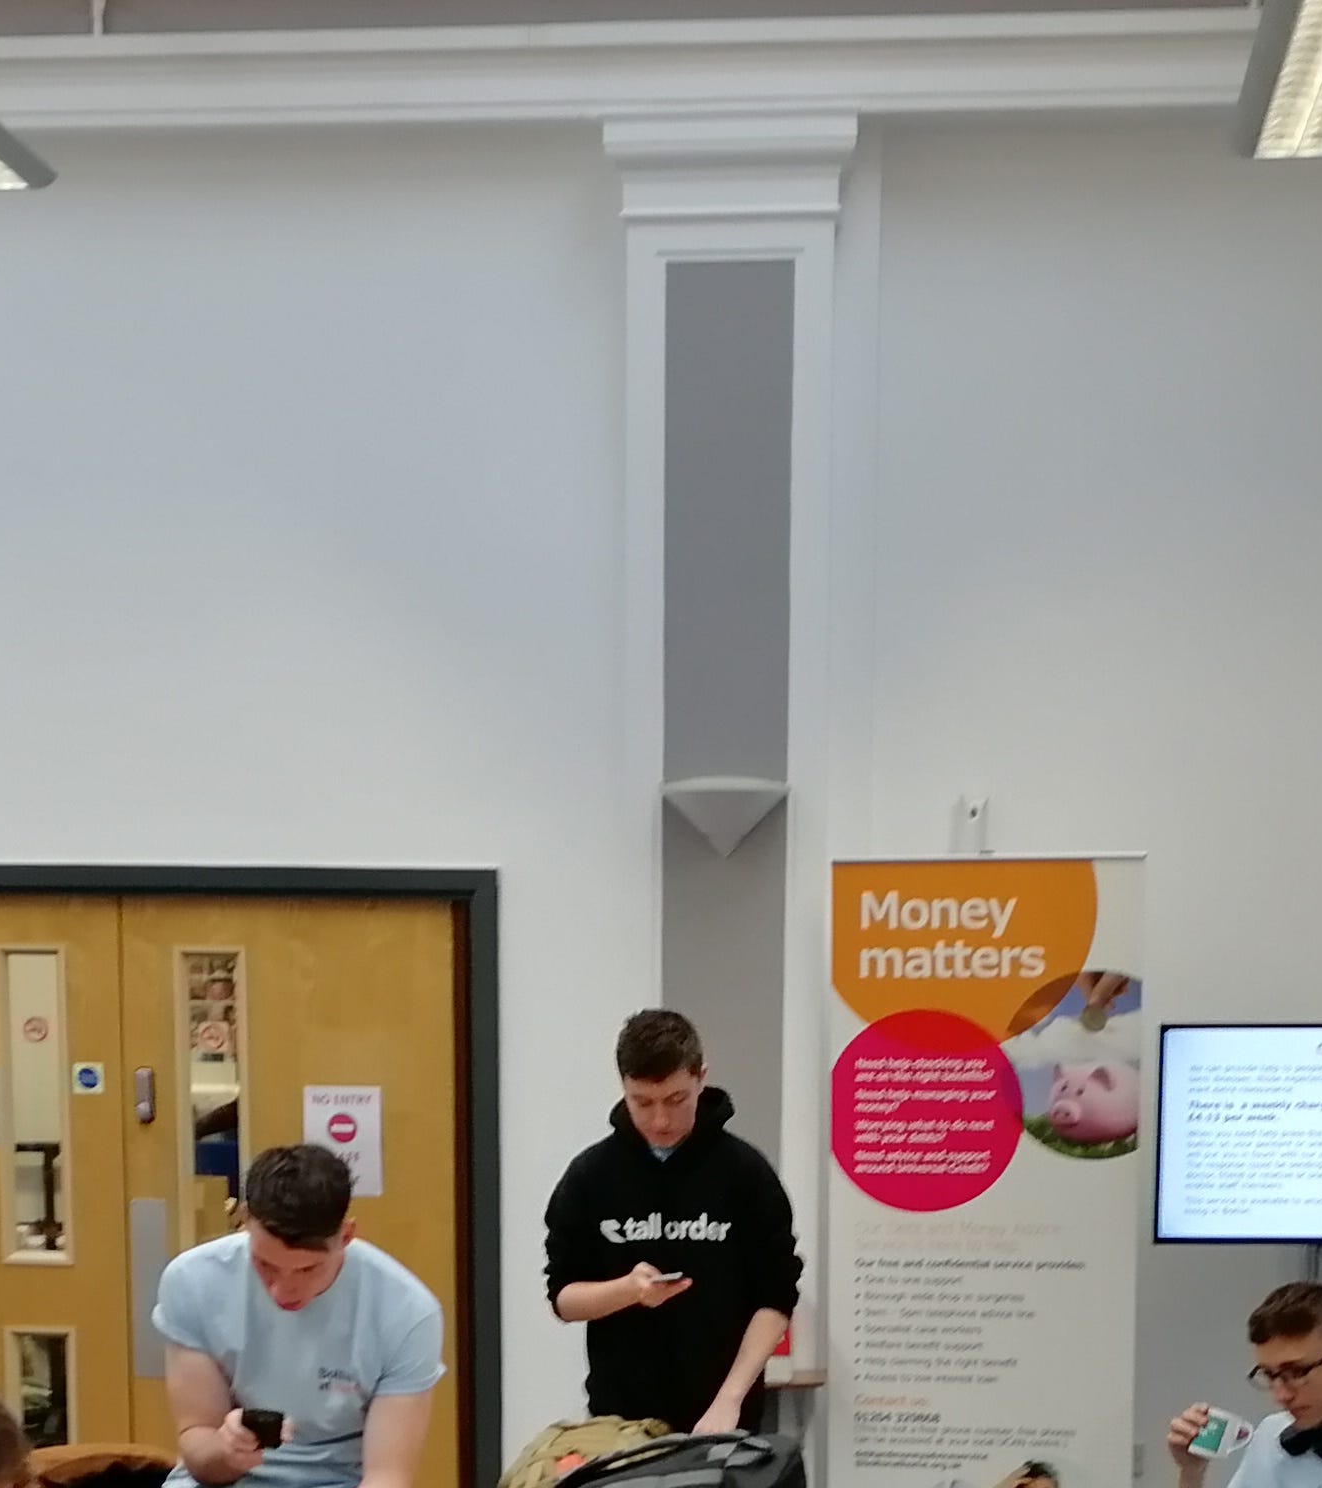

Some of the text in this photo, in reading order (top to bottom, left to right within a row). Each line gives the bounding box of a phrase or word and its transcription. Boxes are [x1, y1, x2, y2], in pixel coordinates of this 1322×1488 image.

[860, 890, 1017, 937] Money
[859, 940, 1046, 979] matters
[624, 1212, 732, 1241] tall order
